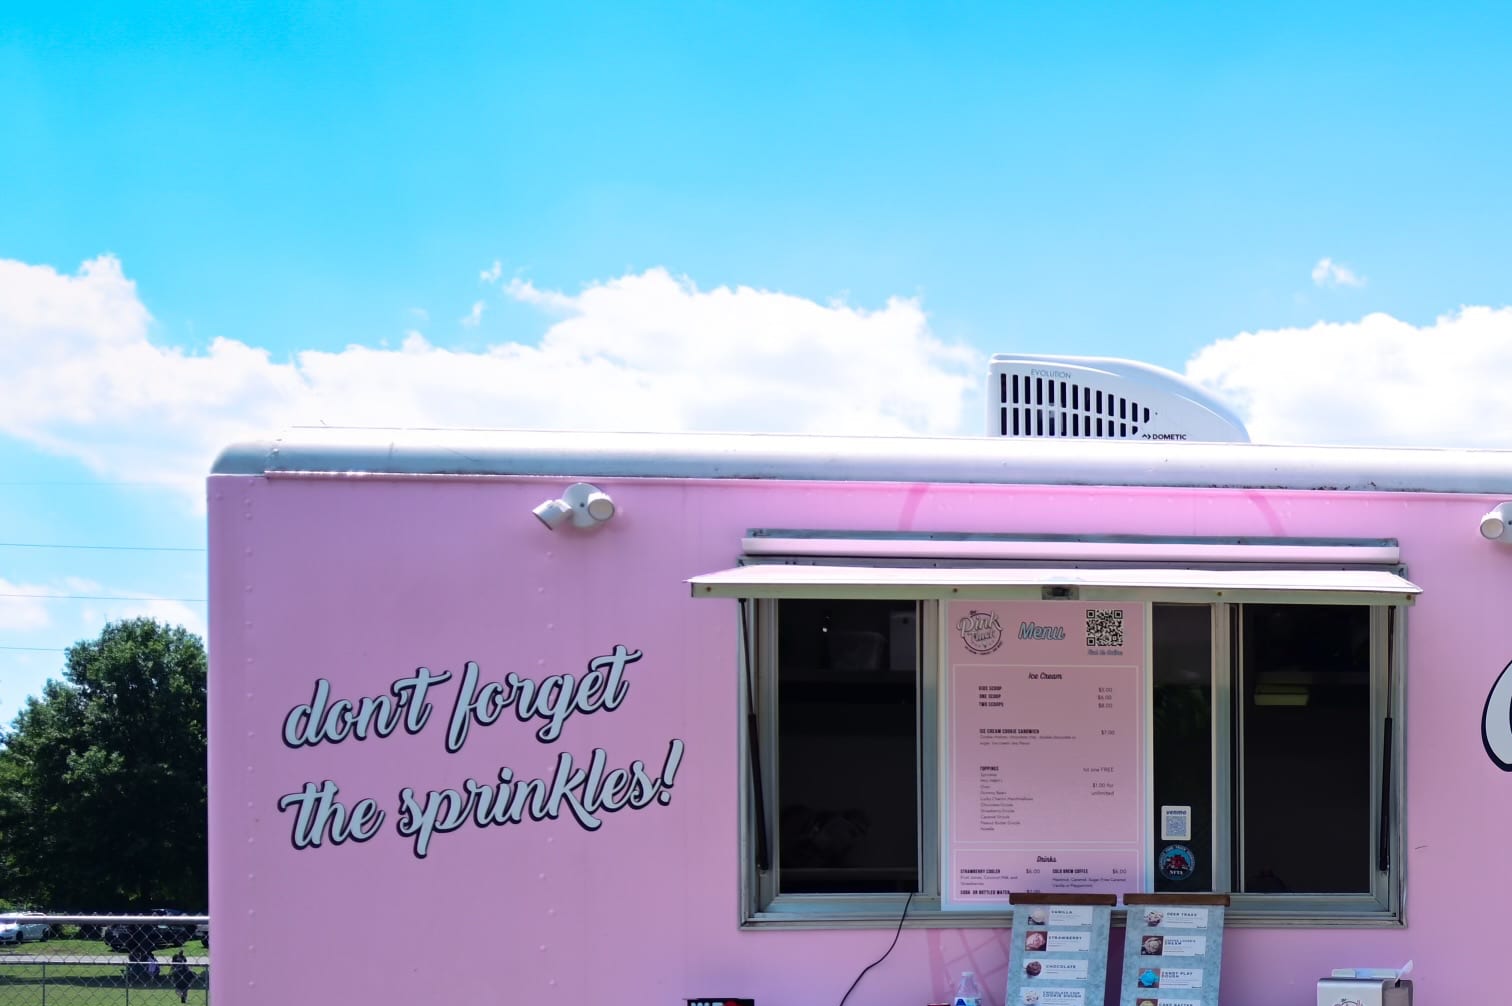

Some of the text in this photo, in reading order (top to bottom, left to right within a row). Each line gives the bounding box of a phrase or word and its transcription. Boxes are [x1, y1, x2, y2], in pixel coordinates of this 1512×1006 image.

[1030, 368, 1072, 380] EVOLUTION
[1018, 621, 1066, 640] Menu
[1028, 672, 1062, 680] Ice Cream
[445, 645, 643, 753] forget
[278, 738, 684, 859] the sprinkles!
